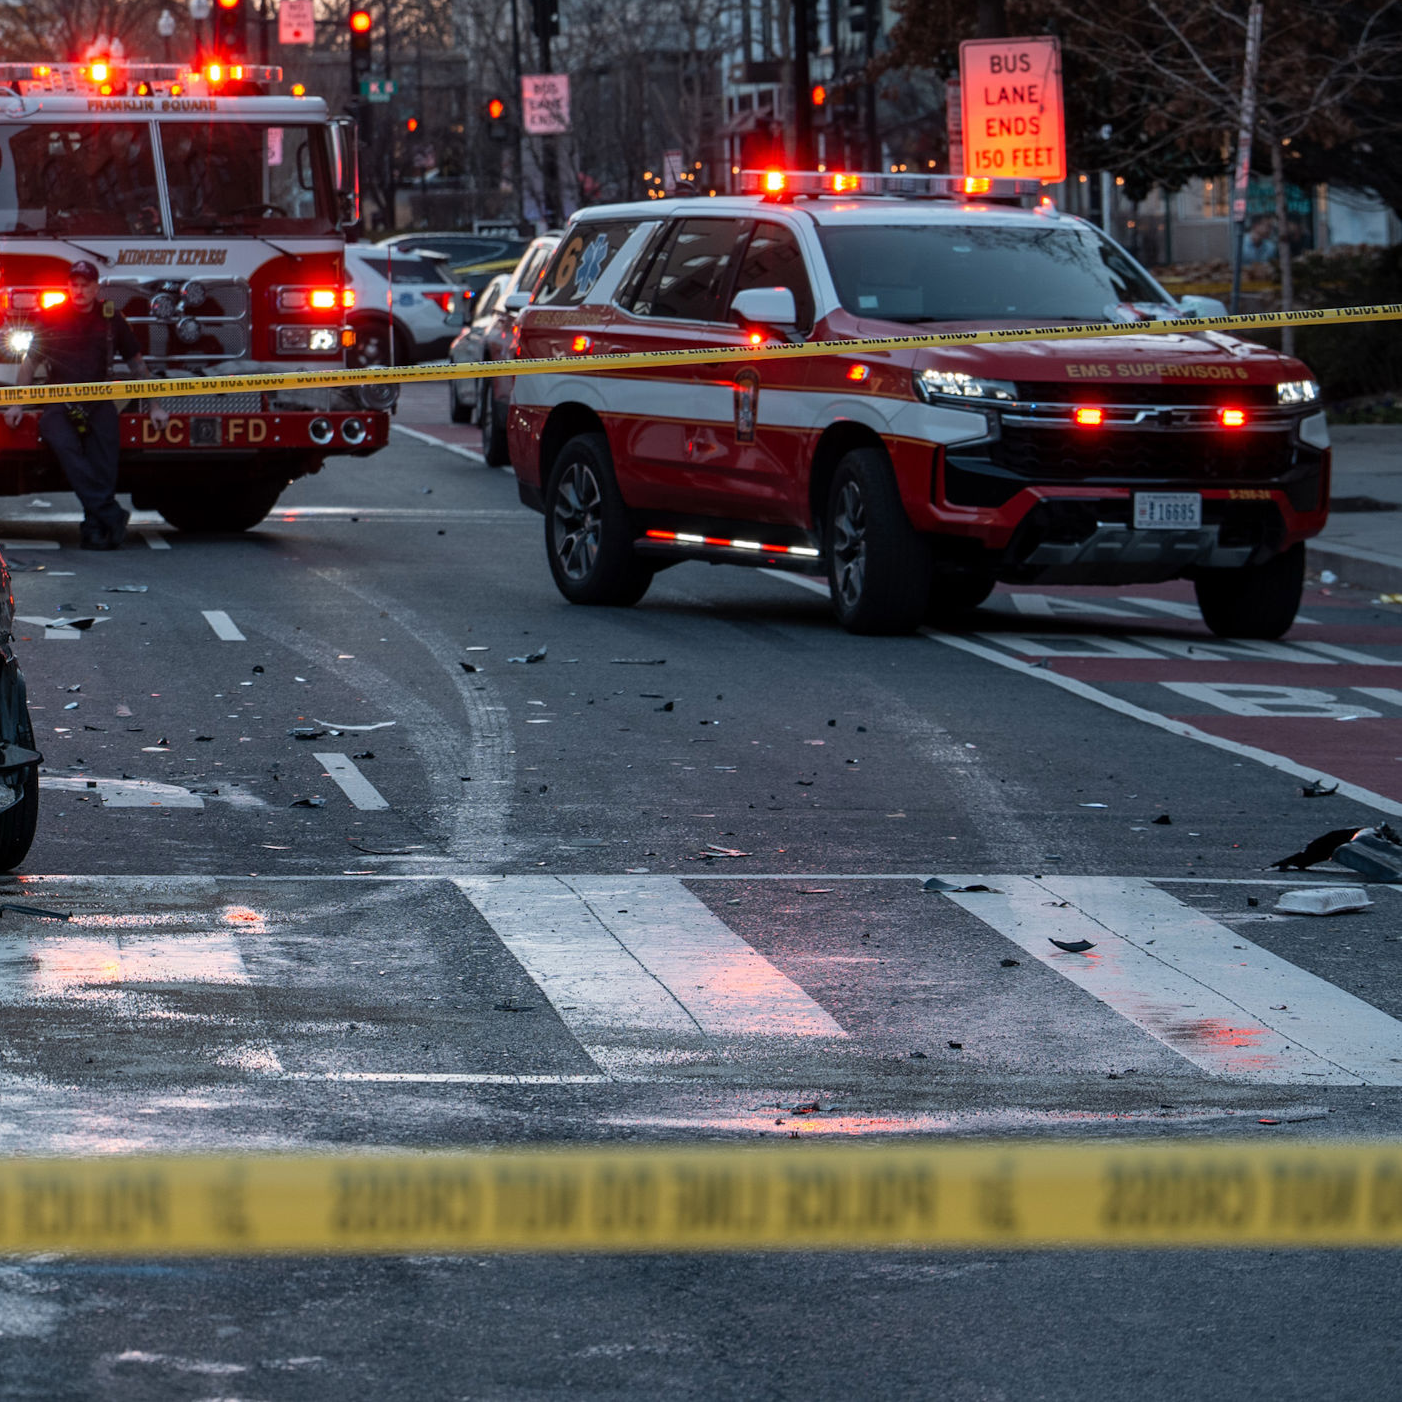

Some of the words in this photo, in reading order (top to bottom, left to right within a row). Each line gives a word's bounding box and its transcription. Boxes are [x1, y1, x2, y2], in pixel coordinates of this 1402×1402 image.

[989, 53, 1031, 75] BUS
[87, 99, 155, 112] FRANKLIN
[161, 99, 218, 112] SQUARE
[984, 84, 1039, 106] LANE
[985, 116, 1041, 138] ENDS
[975, 148, 1005, 169] 150
[1012, 146, 1054, 168] FEET
[554, 237, 584, 289] 6
[1065, 363, 1112, 378] EMS
[1116, 363, 1233, 380] SUPERVISOR
[142, 418, 184, 444] DC
[228, 418, 268, 443] FD
